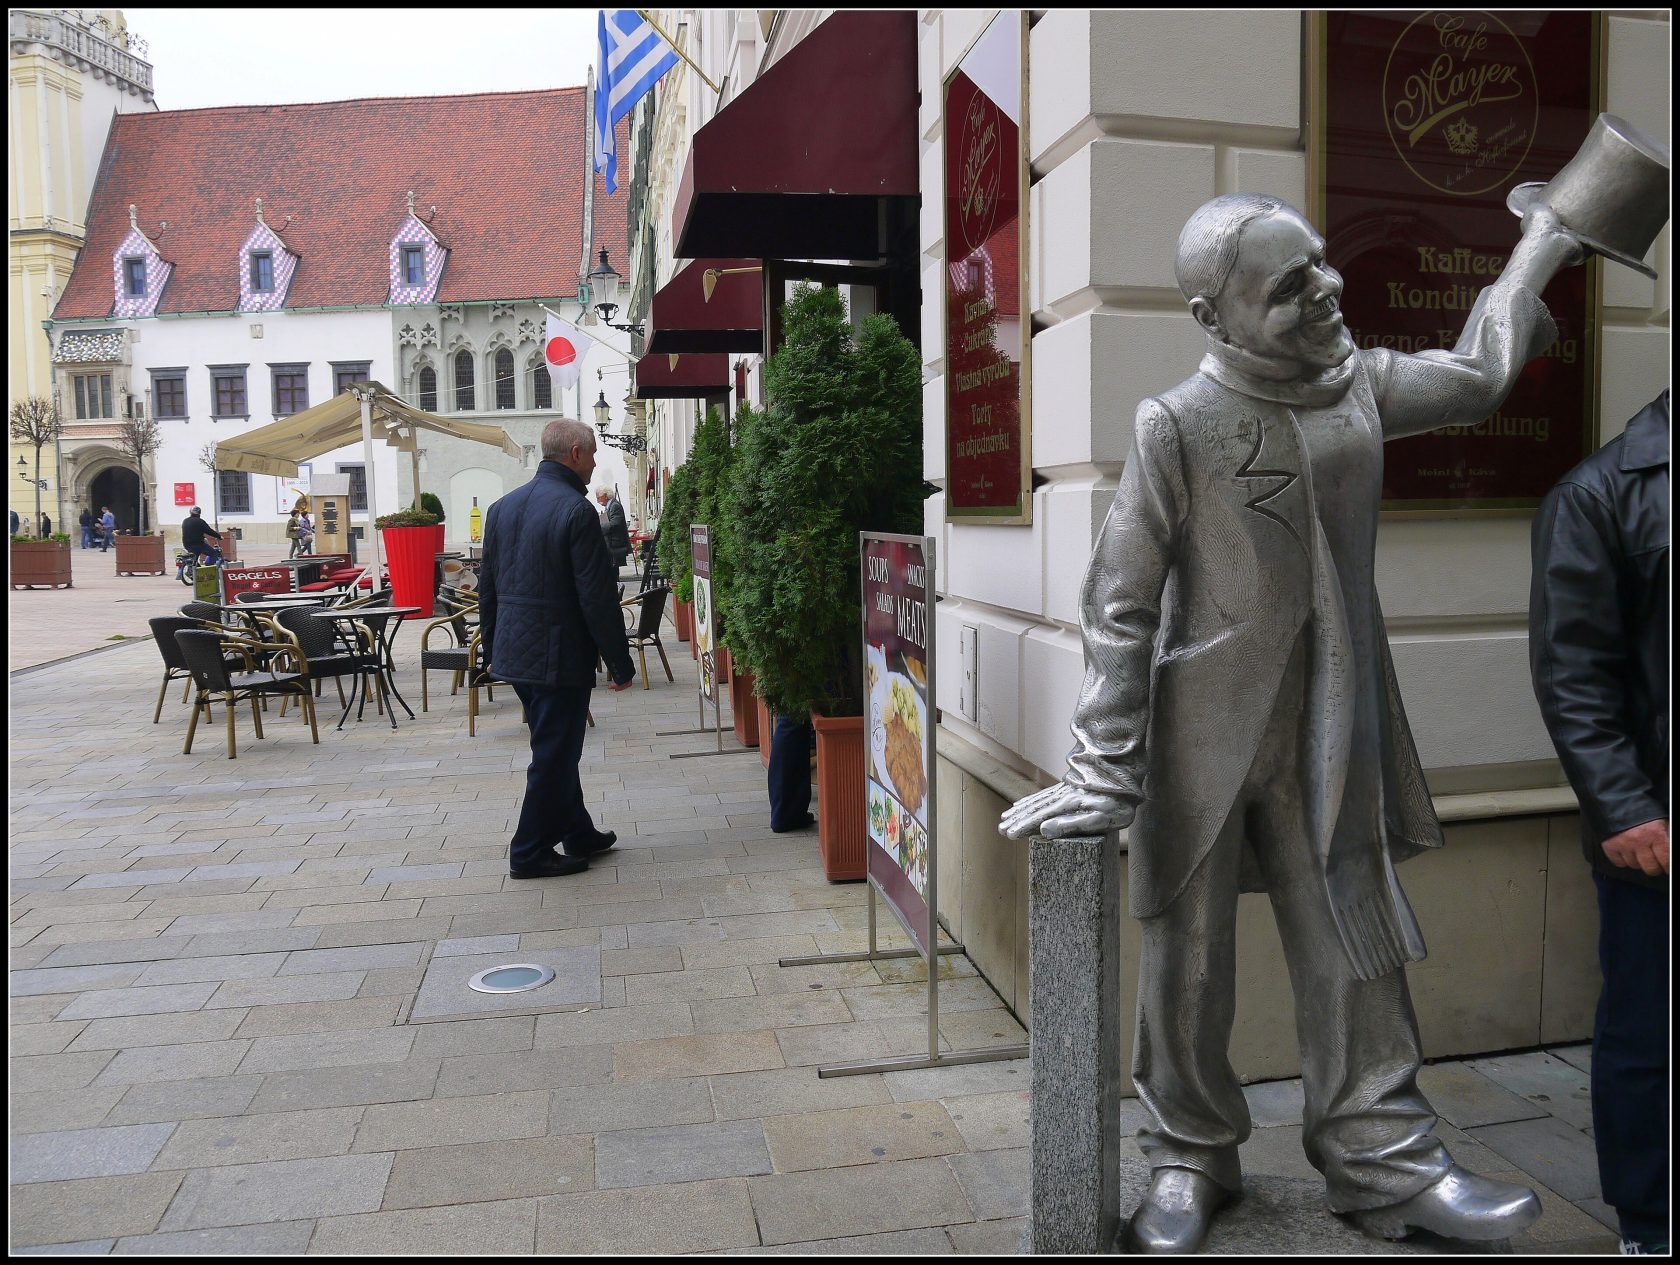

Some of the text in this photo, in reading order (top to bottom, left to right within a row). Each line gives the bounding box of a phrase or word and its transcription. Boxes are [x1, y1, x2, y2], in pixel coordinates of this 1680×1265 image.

[1433, 13, 1488, 62] Cafe
[1394, 53, 1523, 132] Mayer
[1417, 246, 1503, 276] Kaffee
[1387, 282, 1479, 309] Kondit
[1351, 328, 1430, 351] igene
[955, 362, 982, 393] Vlastná
[970, 402, 993, 426] Torty
[965, 427, 1010, 460] objednávku
[227, 571, 282, 581] BAGELS
[868, 555, 925, 589] SOUPS SNACKS
[876, 591, 926, 649] SALADS MEATS
